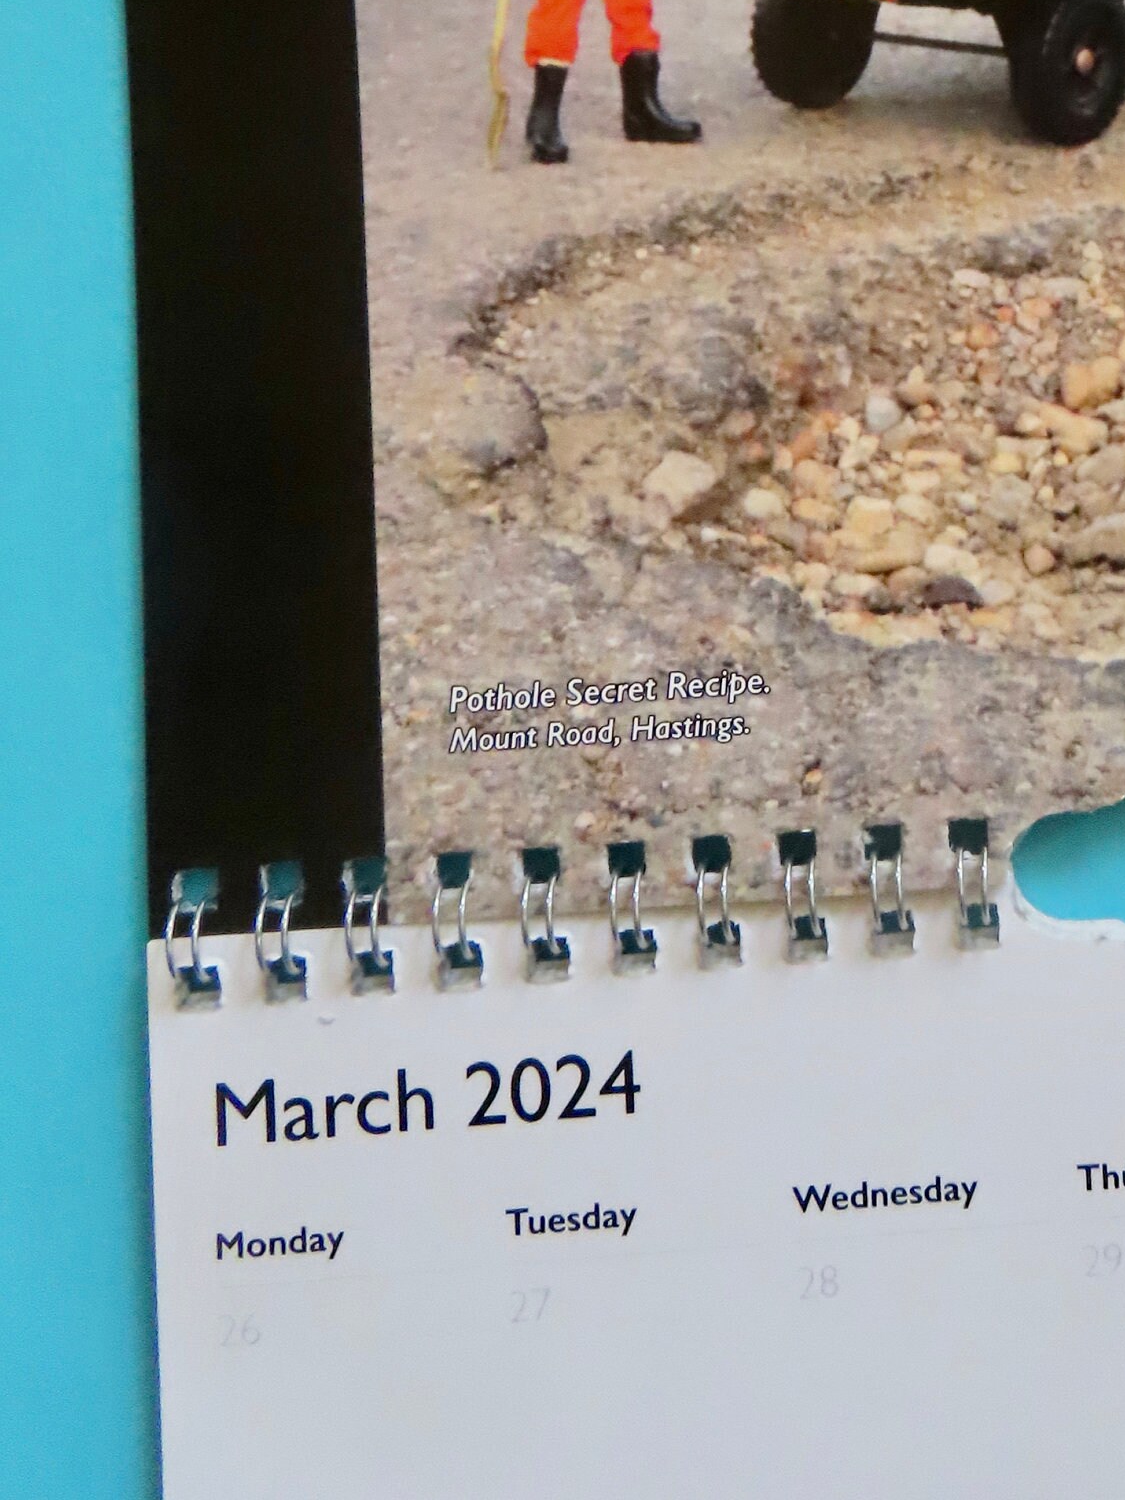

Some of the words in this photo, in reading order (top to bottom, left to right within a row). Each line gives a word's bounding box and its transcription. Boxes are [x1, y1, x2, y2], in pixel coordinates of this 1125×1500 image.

[449, 682, 556, 714] Pothole
[566, 677, 658, 707] Secret
[668, 669, 772, 703] Recipe.
[448, 726, 538, 754] Mount
[546, 718, 622, 747] Road,
[630, 714, 751, 743] Hastings.
[215, 1068, 435, 1147] March
[465, 1049, 642, 1128] 2024
[792, 1174, 978, 1214] Wednesday
[505, 1201, 638, 1238] Tuesday
[216, 1224, 345, 1260] Monday
[1085, 1243, 1124, 1278] 29
[799, 1264, 841, 1301] 28
[510, 1286, 552, 1324] 27
[219, 1313, 263, 1348] 26
